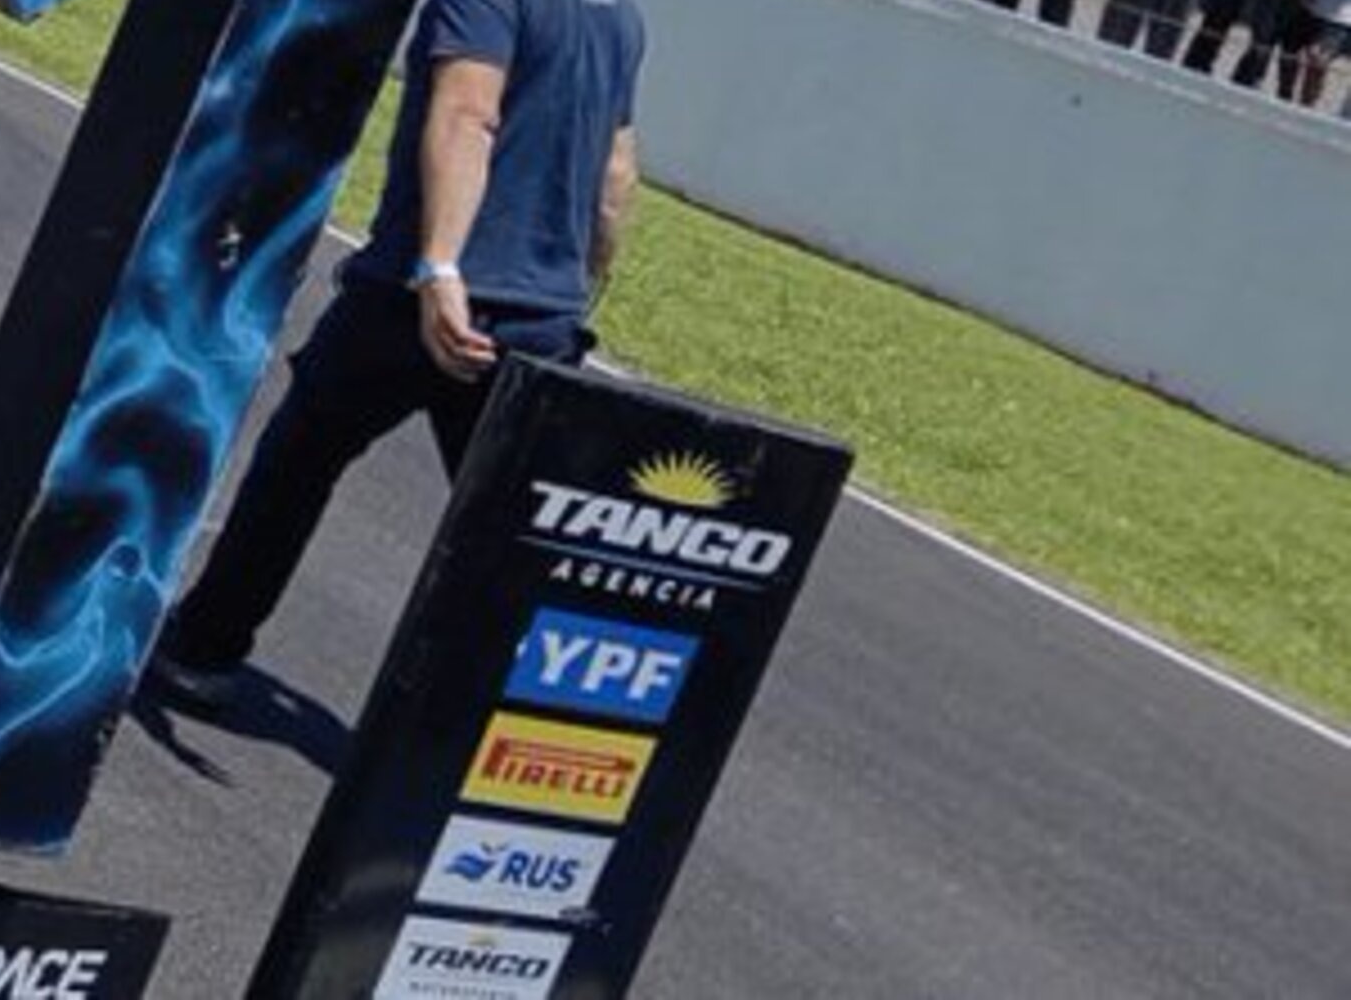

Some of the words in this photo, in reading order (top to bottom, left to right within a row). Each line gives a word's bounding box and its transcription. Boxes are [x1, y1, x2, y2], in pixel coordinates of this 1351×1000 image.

[529, 480, 791, 575] TANGO
[549, 556, 717, 611] AGENCIA
[539, 630, 681, 700] YPF
[481, 736, 636, 798] PIRELLI
[498, 851, 581, 892] RUS
